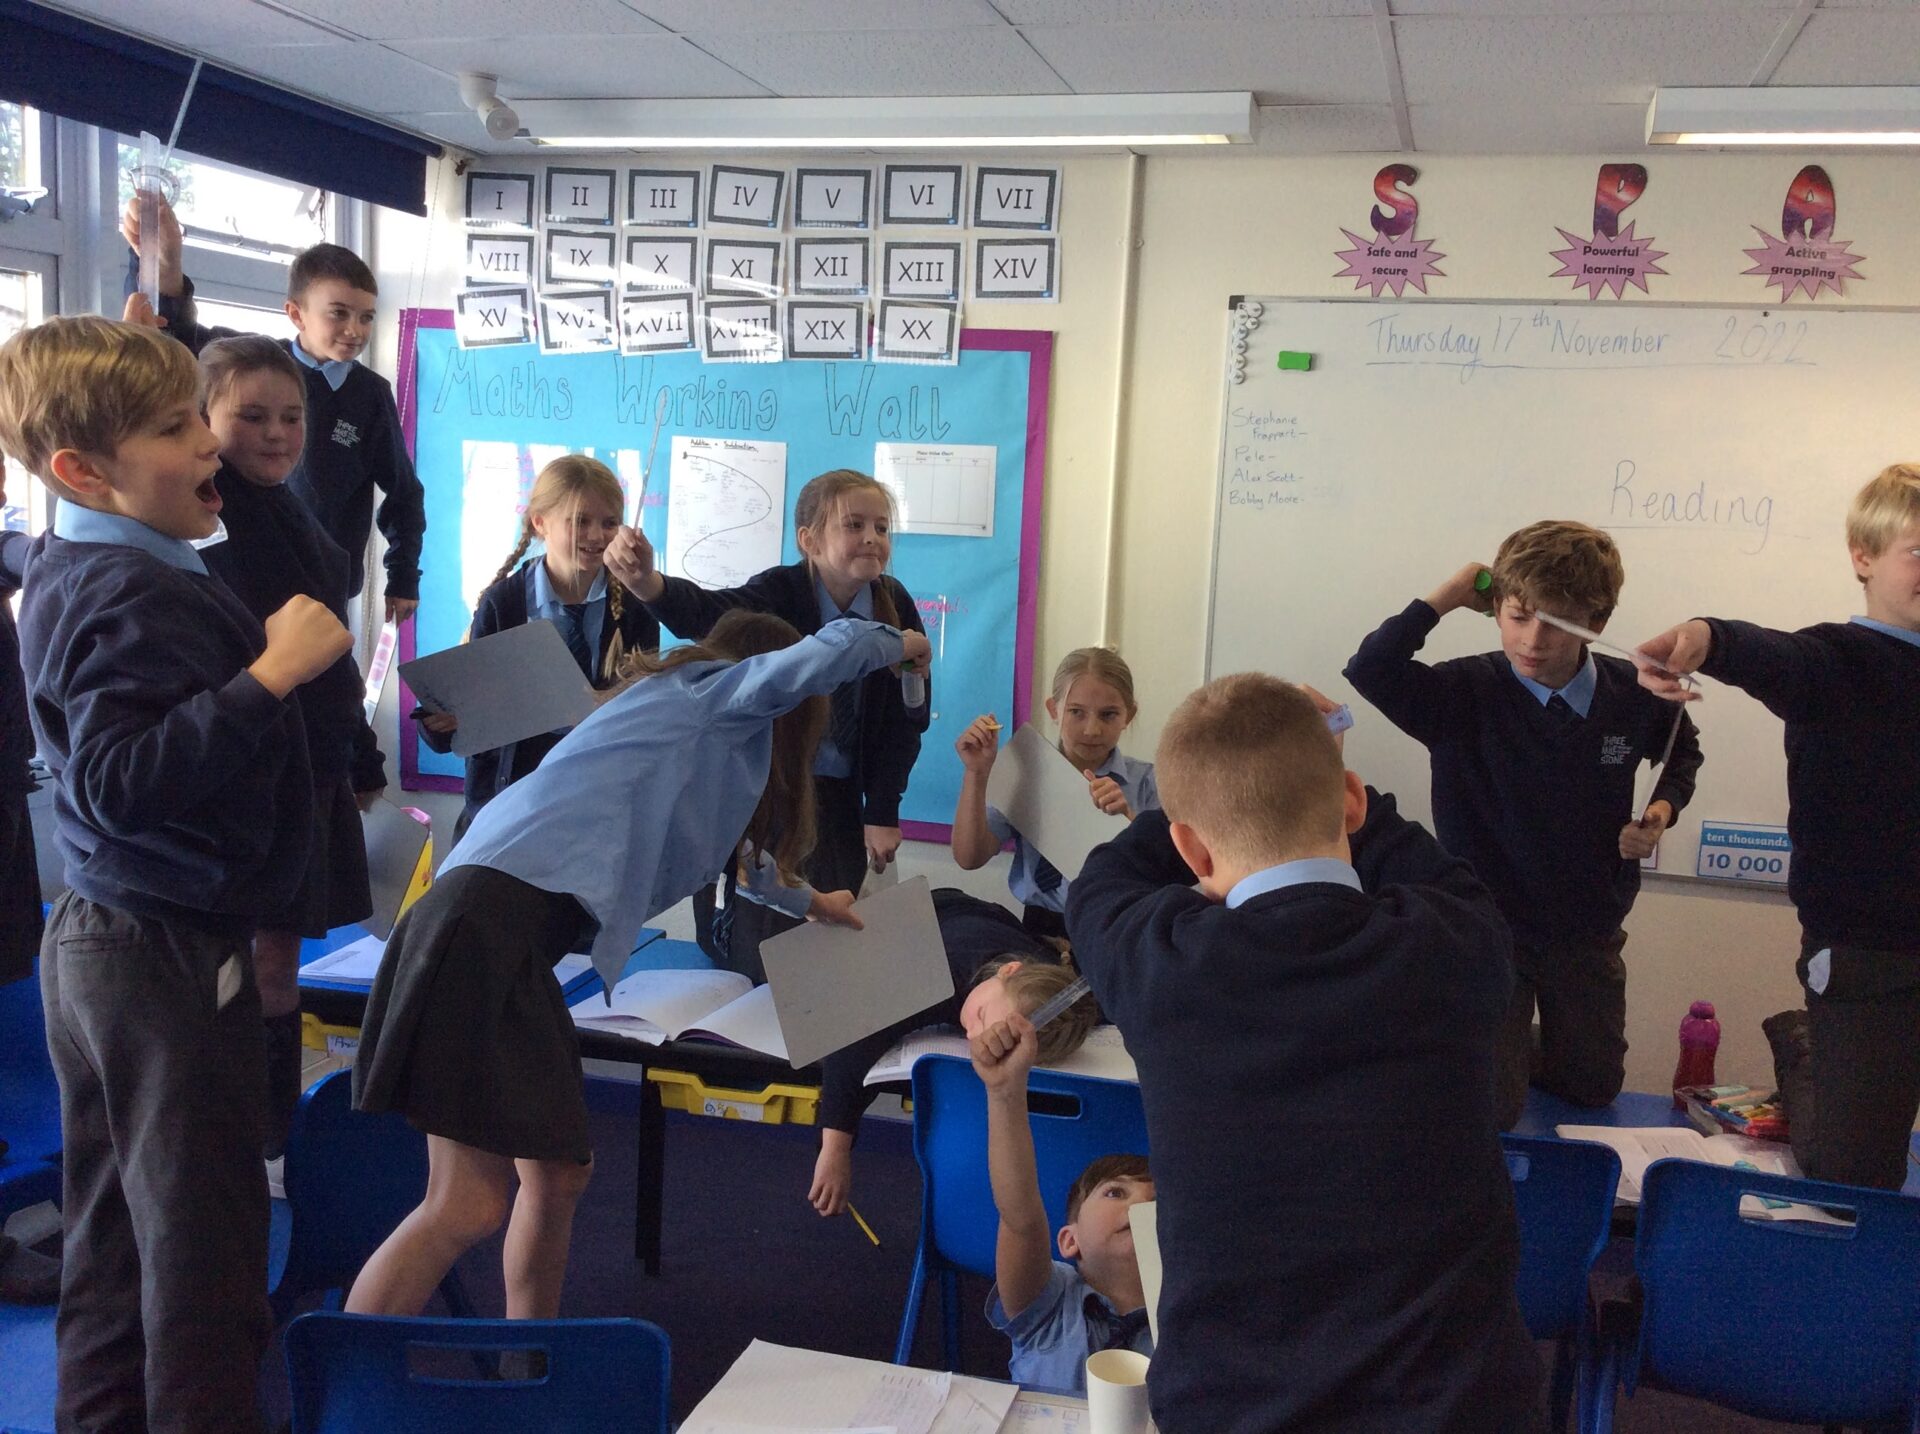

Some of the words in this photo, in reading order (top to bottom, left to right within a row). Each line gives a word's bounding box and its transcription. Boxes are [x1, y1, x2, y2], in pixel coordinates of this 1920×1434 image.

[495, 191, 504, 210] I
[571, 186, 590, 206] II
[650, 188, 677, 209] III
[732, 185, 759, 207] IV
[825, 188, 842, 209] V
[909, 184, 936, 206] VI
[996, 188, 1034, 210] VII
[1371, 163, 1418, 236] S
[1593, 163, 1648, 237] P
[1782, 164, 1836, 241] A
[570, 248, 593, 267] IX
[1367, 246, 1391, 257] Safe
[1394, 248, 1418, 259] and
[1583, 245, 1640, 257] Powerful
[1785, 246, 1828, 260] Active
[479, 252, 520, 272] VIII
[654, 254, 669, 274] X
[729, 258, 755, 279] XI
[813, 256, 848, 277] XII
[897, 261, 945, 283] XIII
[992, 257, 1038, 280] XIV
[1372, 266, 1409, 276] secure
[1583, 264, 1635, 277] learning
[1771, 266, 1836, 280] grappling
[478, 307, 507, 327] XV
[557, 308, 596, 329] XVI
[804, 320, 846, 341] XIX
[900, 319, 934, 340] XX
[1367, 313, 1481, 385] Thursday
[1551, 319, 1669, 356] November
[1715, 315, 1812, 364] 2022
[433, 347, 573, 421] Maths
[613, 353, 779, 432] Working
[824, 362, 951, 441] Wall
[1610, 459, 1773, 555] Reading
[1707, 832, 1725, 843] ten
[1728, 834, 1788, 847] thousands
[1706, 853, 1731, 869] 10
[1738, 856, 1783, 873] 000
